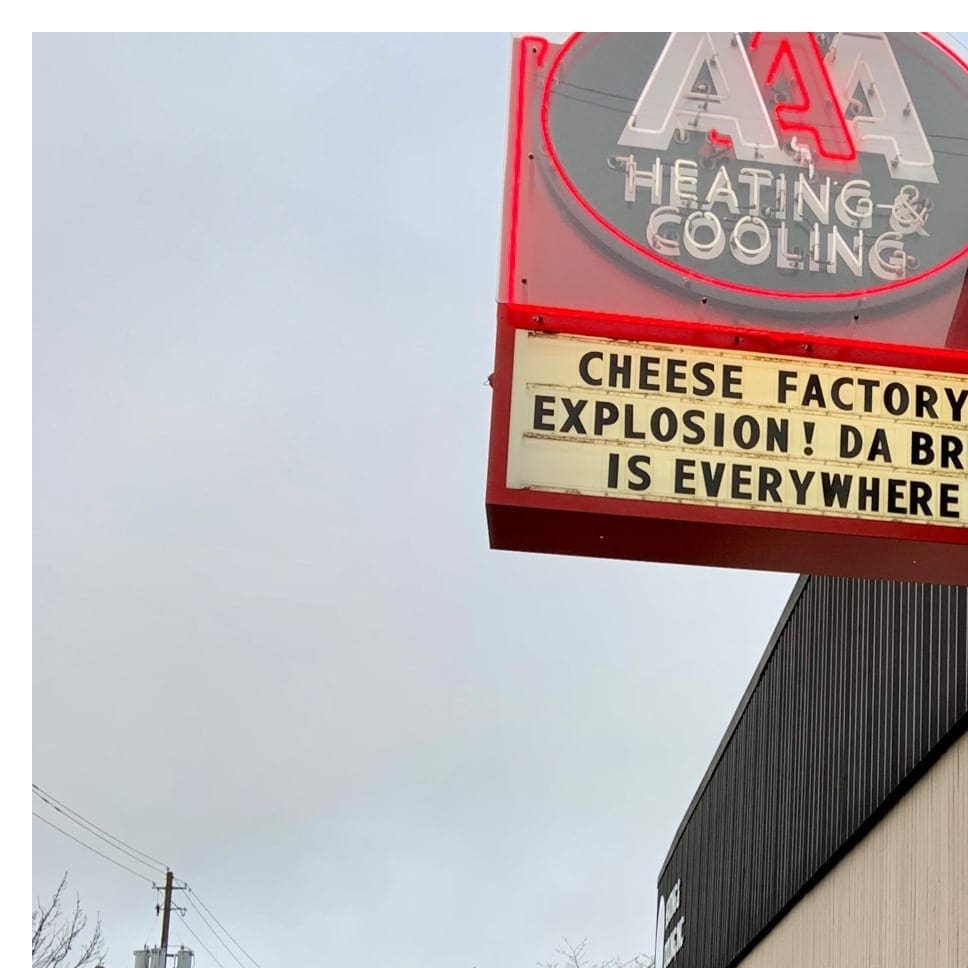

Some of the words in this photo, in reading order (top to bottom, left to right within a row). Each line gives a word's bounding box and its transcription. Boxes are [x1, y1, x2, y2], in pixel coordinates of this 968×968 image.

[617, 32, 940, 184] AAA
[622, 157, 873, 229] HEATING
[888, 184, 930, 237] &
[645, 207, 908, 281] COOLING
[579, 351, 743, 400] CHEESE
[532, 394, 815, 455] EXPLOSION!
[840, 424, 892, 462] DA
[607, 453, 651, 491] IS
[674, 459, 959, 518] EVERYWHERE
